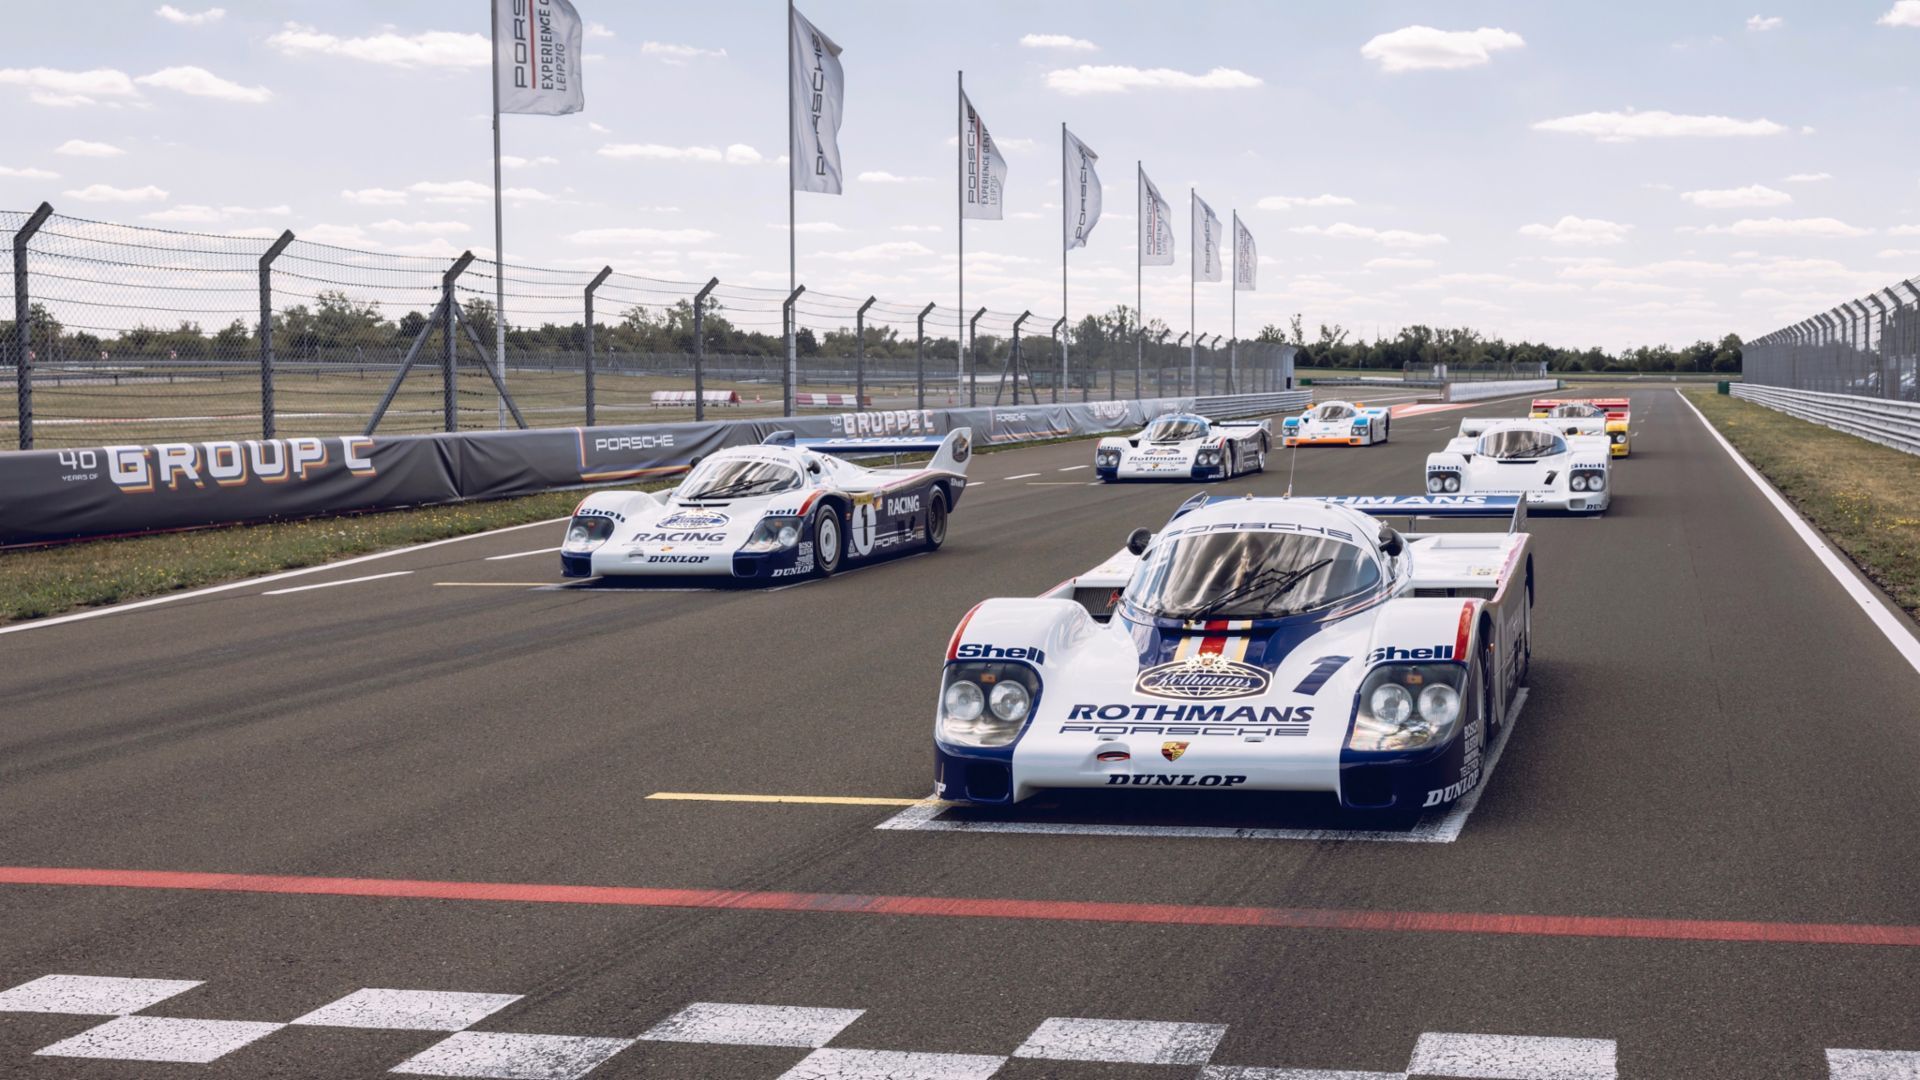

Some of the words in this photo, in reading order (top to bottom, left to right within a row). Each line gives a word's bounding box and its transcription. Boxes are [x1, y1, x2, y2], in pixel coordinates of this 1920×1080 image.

[539, 9, 554, 90] EXPERIENCE
[555, 43, 567, 92] LEIPZIG
[967, 104, 977, 204] PORSCHE
[981, 157, 990, 205] EXPERIENCE
[989, 175, 998, 206] LEIPZIG
[830, 415, 841, 427] 40
[841, 411, 921, 437] GRUPPE
[595, 434, 674, 452] PORSCHE
[58, 447, 98, 471] 40
[103, 437, 328, 494] GROUP
[338, 436, 377, 477] C
[887, 494, 920, 516] RACING
[1324, 496, 1487, 505] HMANS
[580, 507, 626, 523] Shell
[765, 508, 798, 518] hell
[862, 503, 869, 546] 1
[1167, 522, 1354, 542] PORSCHE
[631, 532, 727, 542] RACING
[874, 529, 926, 549] PORCHE
[647, 555, 710, 563] DUNLOP
[771, 564, 815, 578] DUNLOP
[957, 643, 1046, 666] Shell
[1364, 645, 1454, 667] Shell
[1155, 671, 1252, 688] Rothmans
[1292, 655, 1354, 696] 1
[1067, 704, 1315, 723] ROTHMANS
[1058, 726, 1310, 737] PORSCHE
[1104, 774, 1248, 787] DUNLOP
[1422, 767, 1480, 807] DUNLOP
